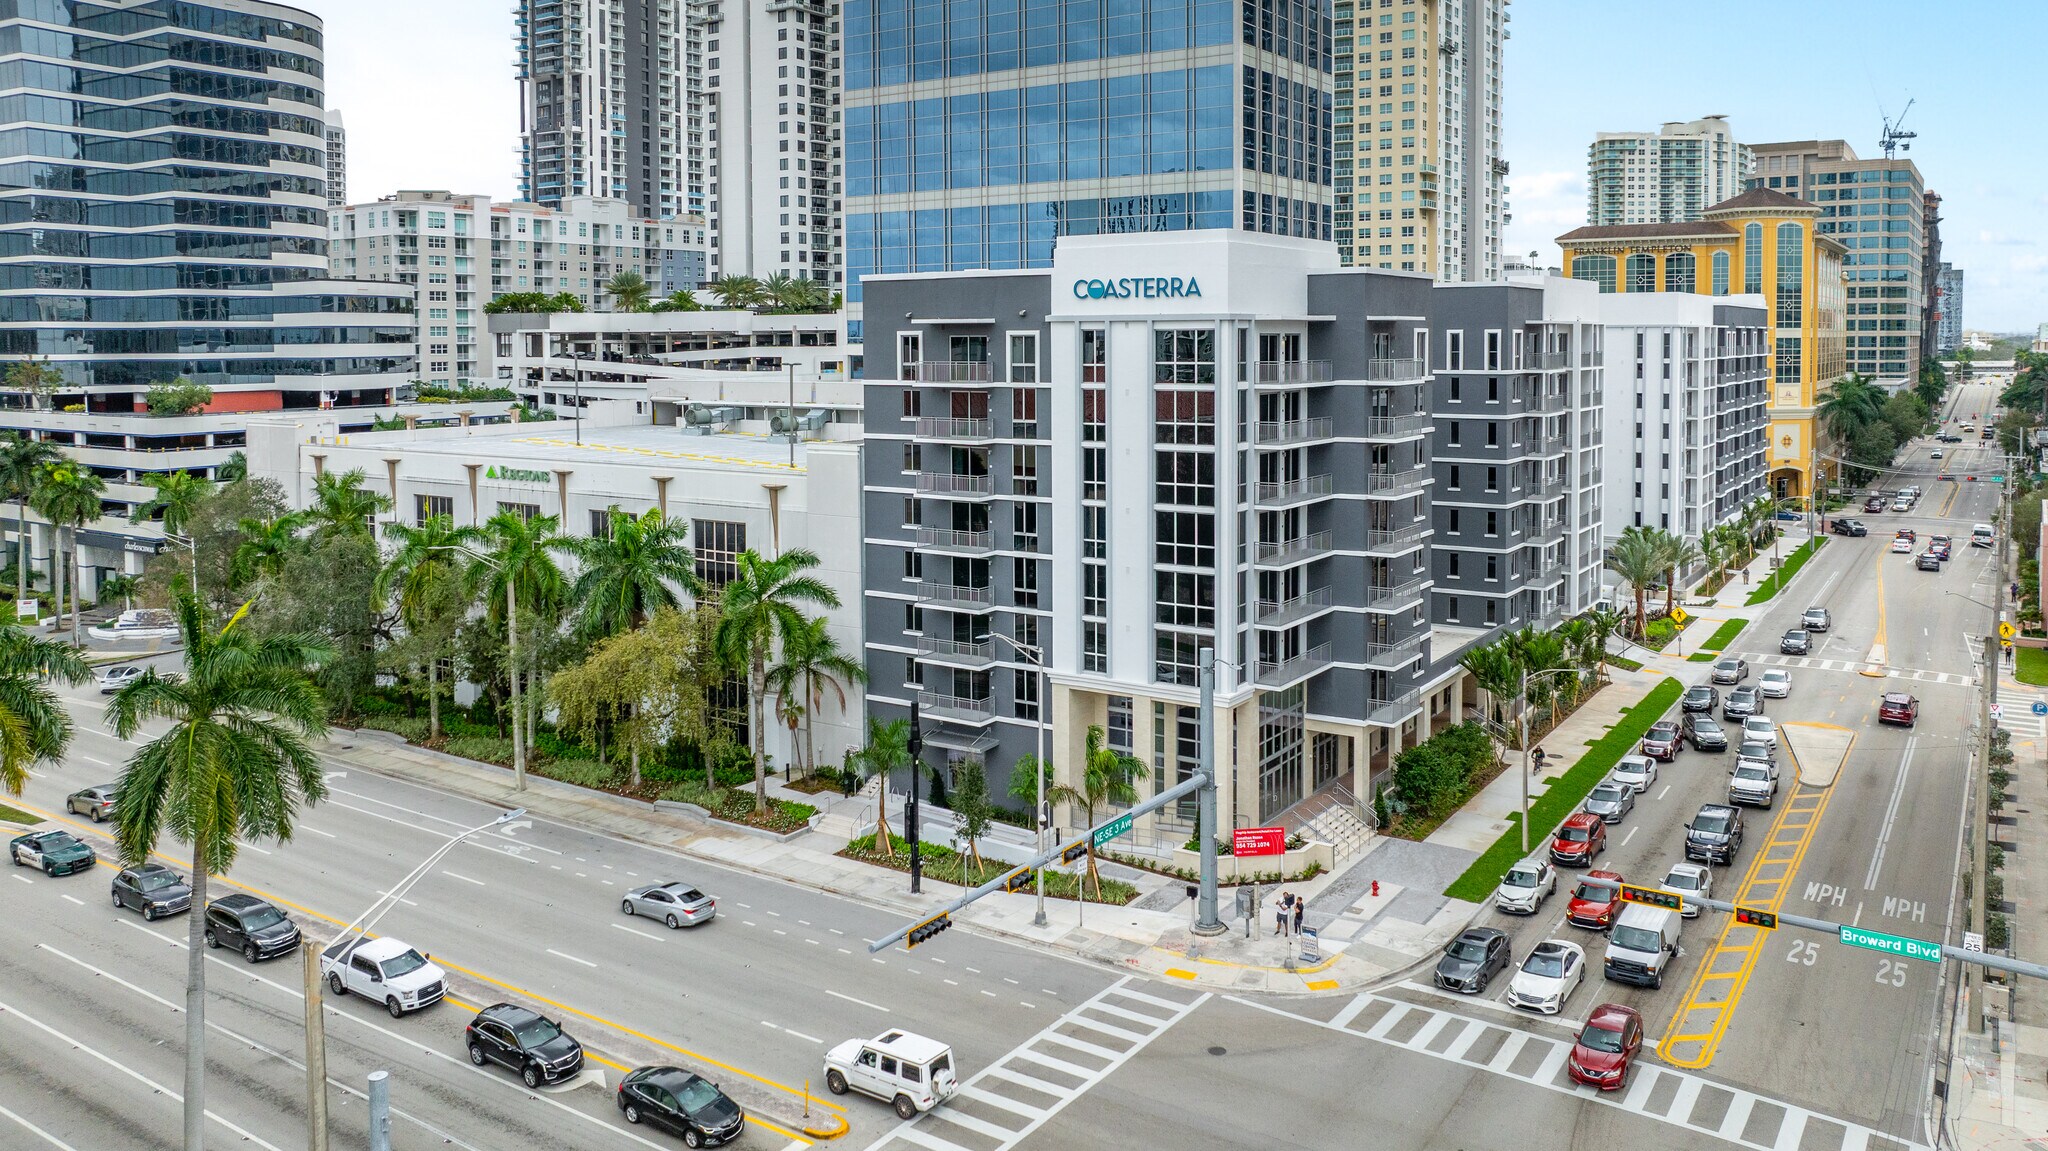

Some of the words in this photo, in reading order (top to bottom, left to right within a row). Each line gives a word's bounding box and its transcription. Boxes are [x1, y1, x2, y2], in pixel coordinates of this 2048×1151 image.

[1574, 246, 1625, 255] FRANKLIN
[1629, 244, 1692, 253] TEMPLETON
[1073, 276, 1202, 299] COASTERRA
[1094, 827, 1113, 844] NE-SE
[1115, 824, 1119, 834] 3
[1120, 819, 1132, 831] Ave
[1803, 881, 1847, 907] MPH
[1882, 895, 1926, 923] MPH
[1786, 939, 1820, 966] 25
[1842, 930, 1901, 950] Broward
[1907, 942, 1939, 959] Blvd
[1965, 943, 1981, 952] 25
[1875, 959, 1908, 988] 25
